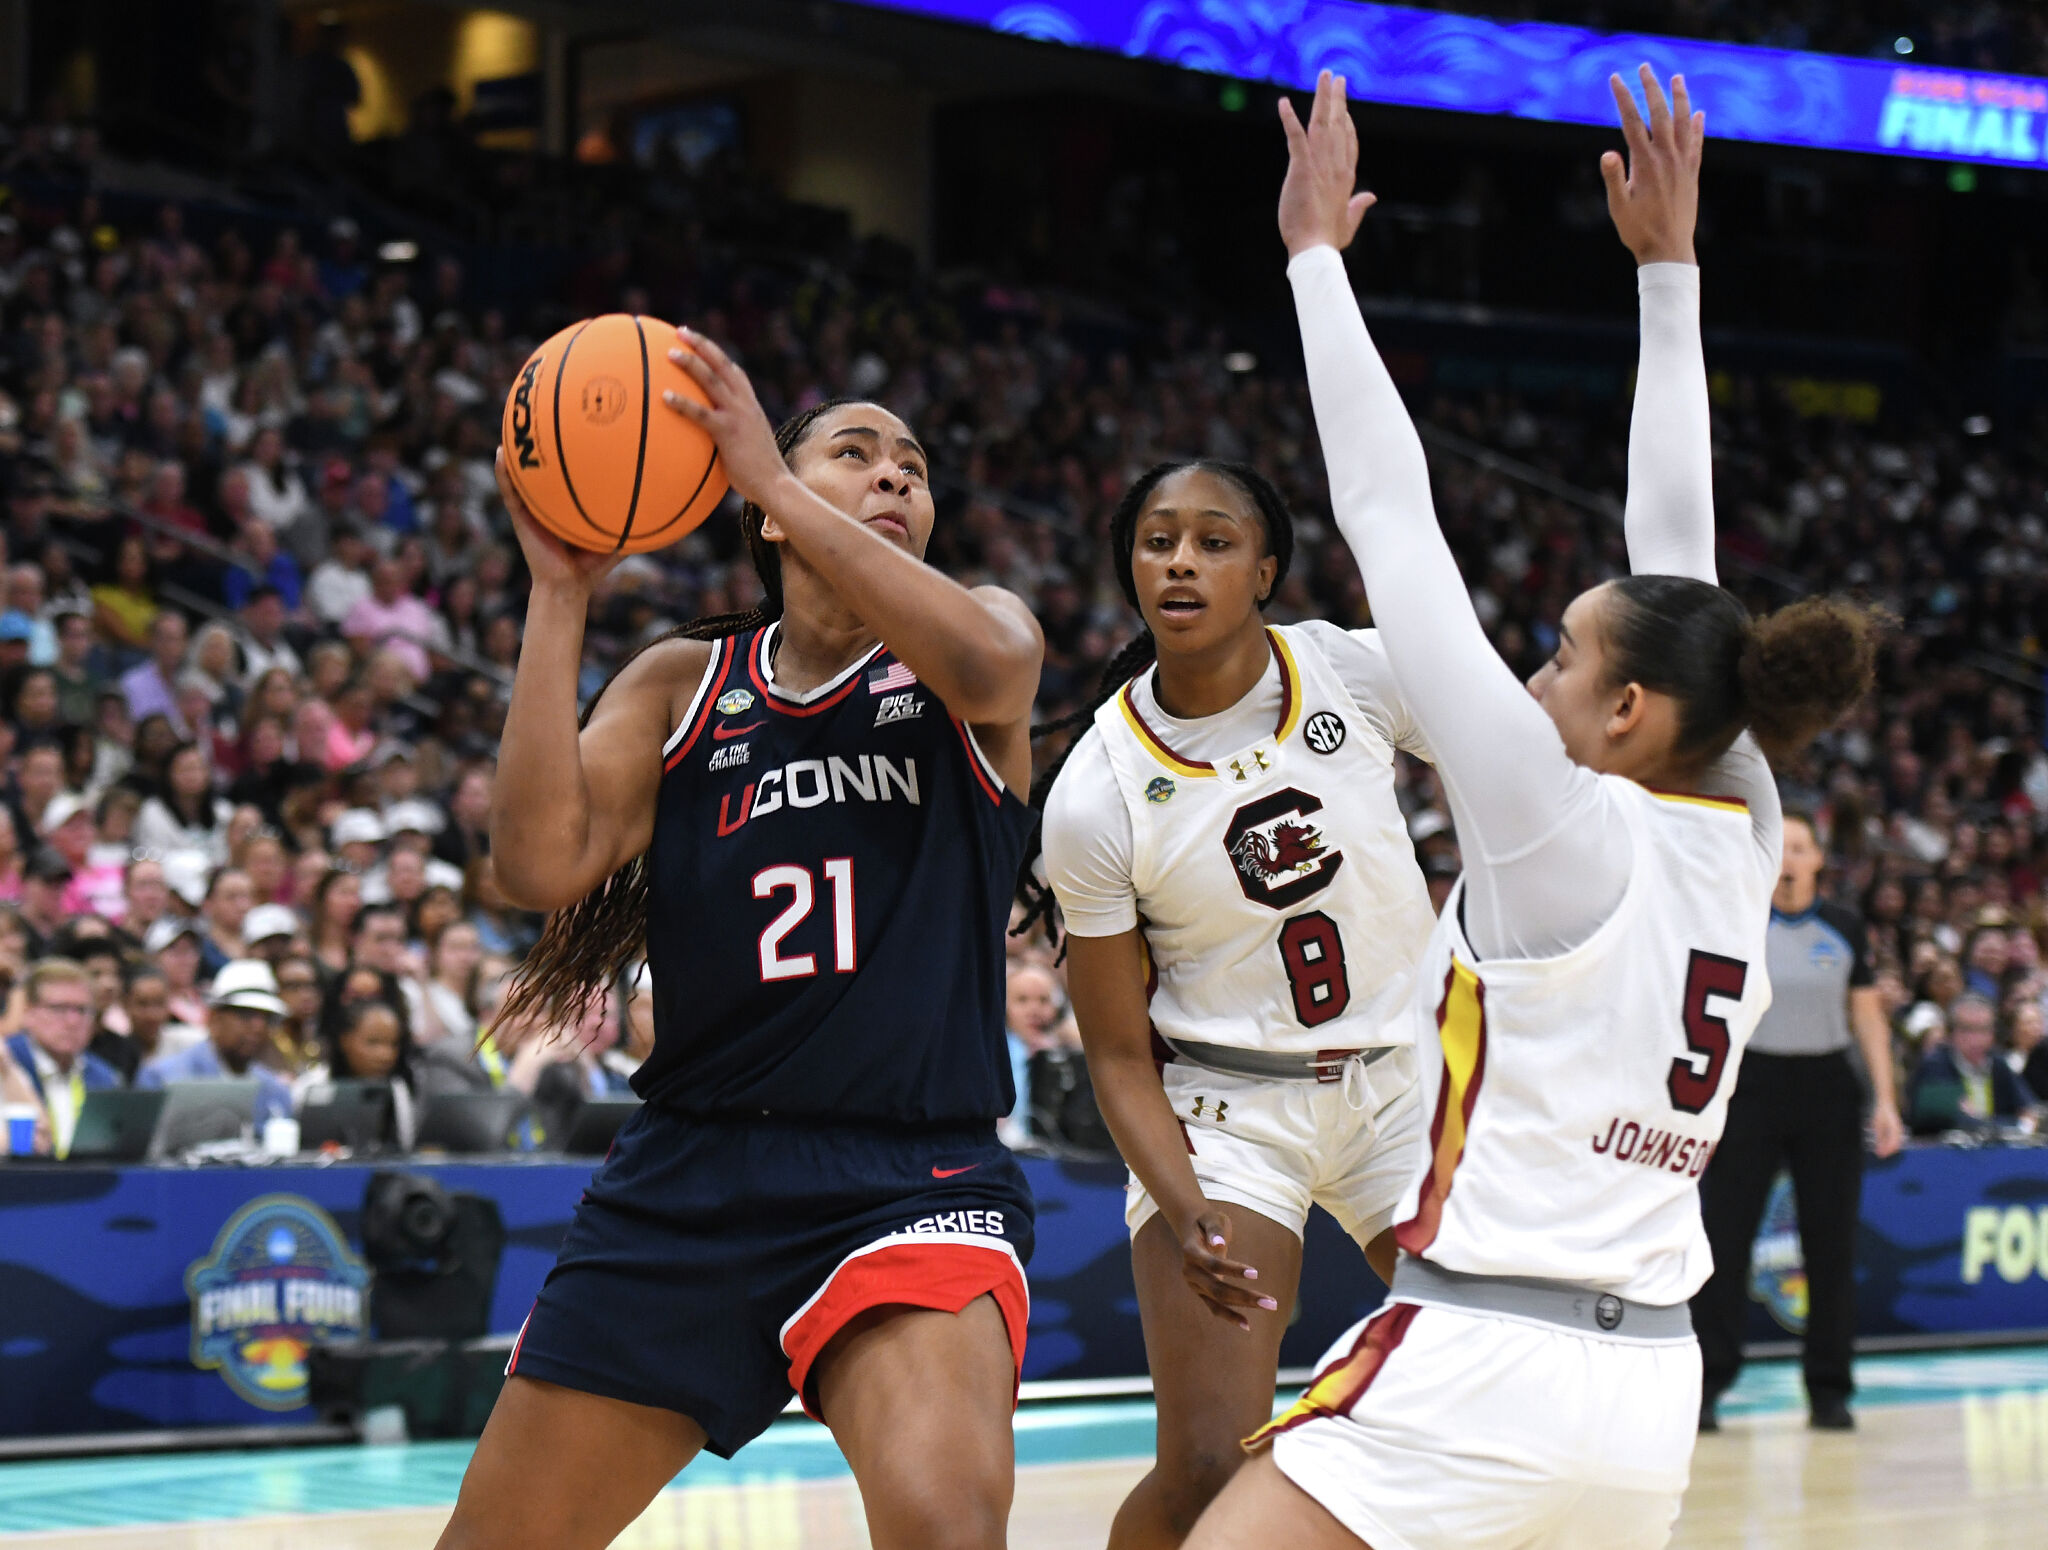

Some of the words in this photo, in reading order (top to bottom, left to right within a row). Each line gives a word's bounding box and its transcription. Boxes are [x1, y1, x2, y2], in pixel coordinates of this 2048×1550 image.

[513, 356, 544, 470] NCAA
[875, 702, 925, 724] EAST
[880, 692, 914, 710] BIG
[729, 742, 750, 757] THE
[1306, 713, 1343, 752] SEC
[708, 752, 750, 772] CHANGE
[717, 755, 921, 837] UCONN
[751, 856, 857, 983] 21
[1277, 910, 1350, 1029] 8
[1667, 948, 1748, 1115] 5
[890, 1210, 1005, 1236] SKIES
[200, 1280, 278, 1336] FINAL
[283, 1278, 361, 1333] FOUR
